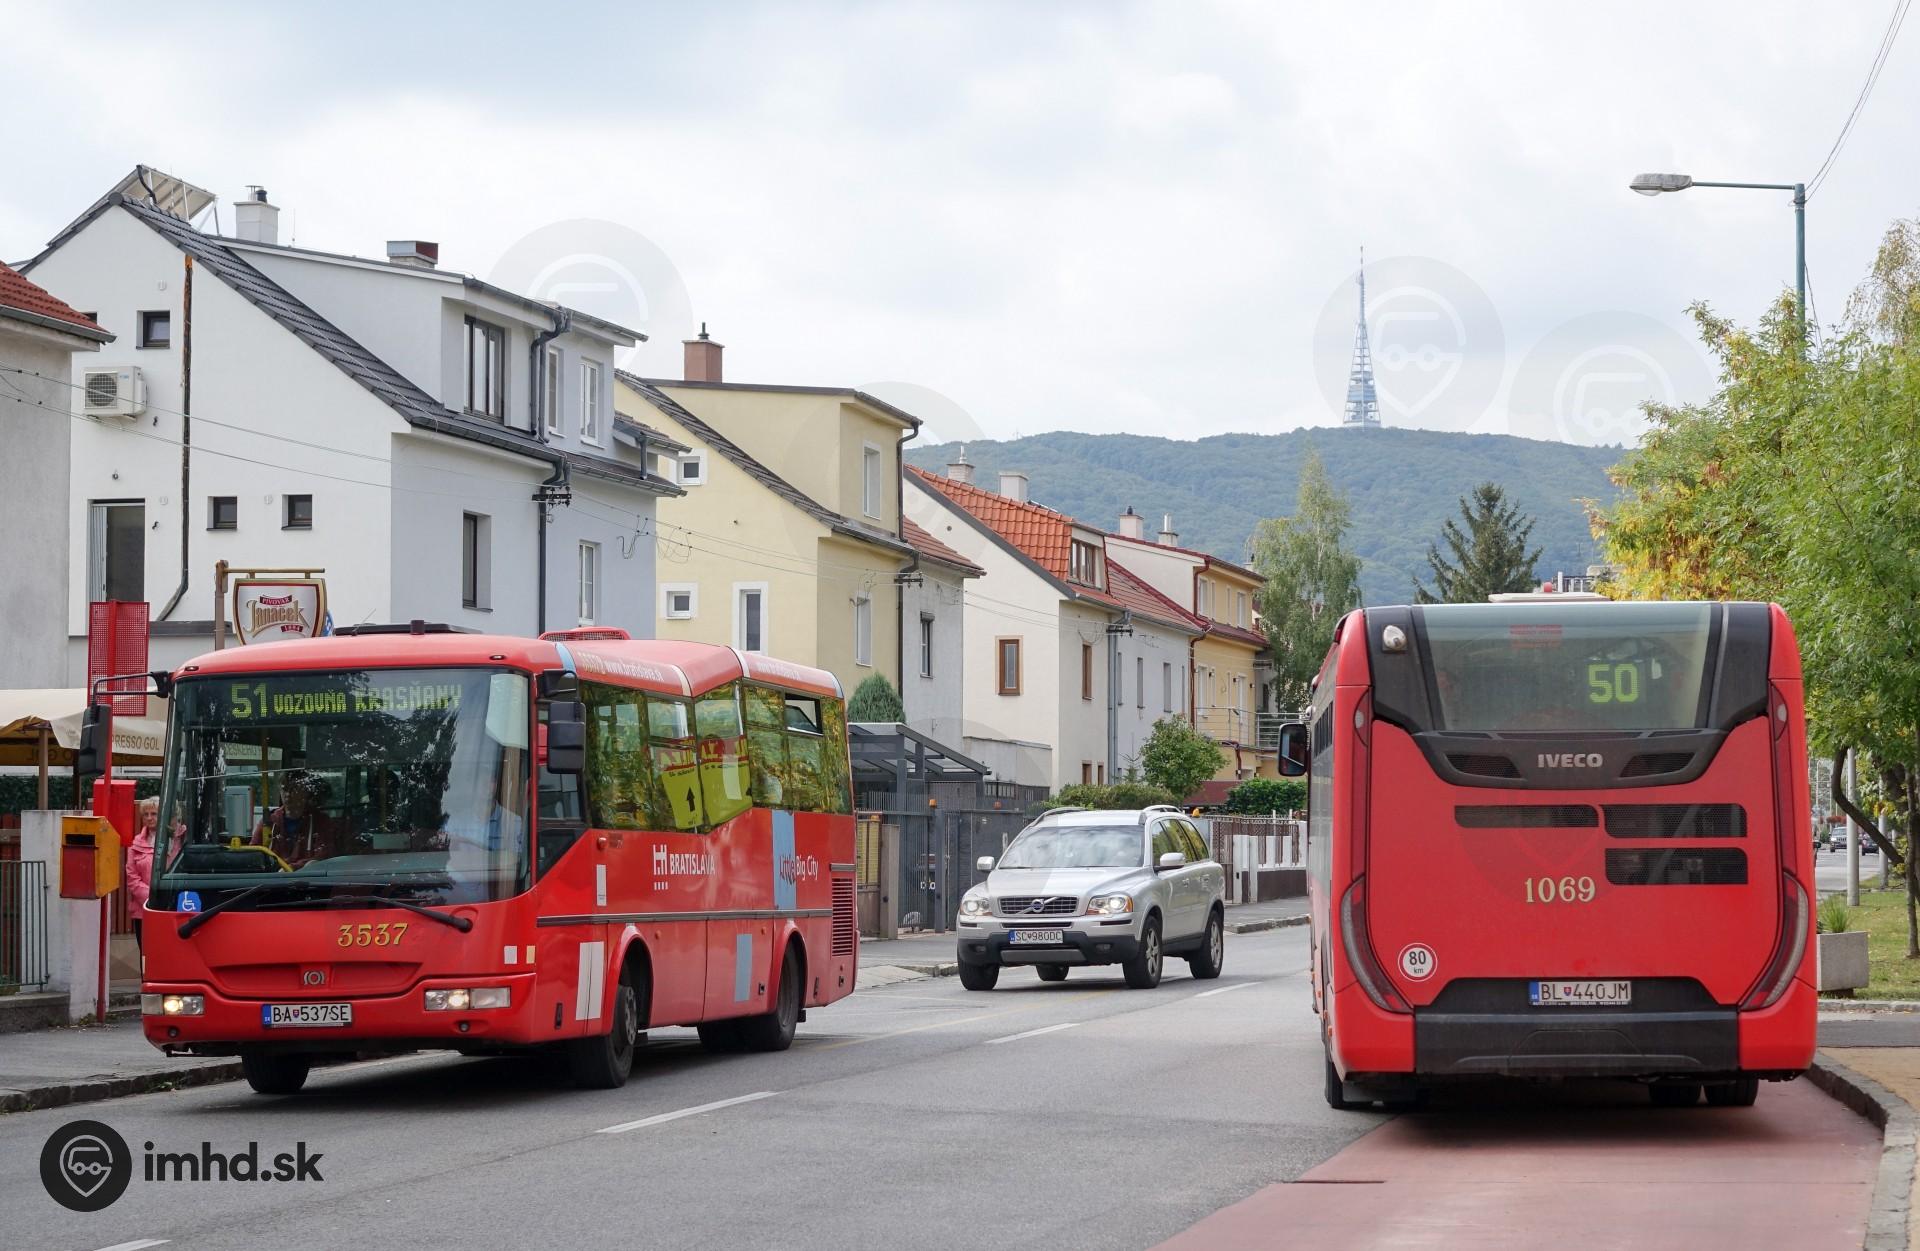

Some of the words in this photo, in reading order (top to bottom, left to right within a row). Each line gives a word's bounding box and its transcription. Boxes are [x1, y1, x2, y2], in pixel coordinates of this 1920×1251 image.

[1588, 663, 1640, 703] 50
[231, 683, 268, 718] 51
[143, 736, 160, 750] GOL
[1537, 753, 1604, 768] IVECO
[669, 852, 716, 875] BRATISLAVA
[796, 855, 806, 881] Big
[806, 854, 819, 881] City
[1525, 876, 1596, 903] 1069
[337, 922, 408, 947] 3537
[1409, 950, 1427, 966] 80
[1413, 966, 1424, 974] km
